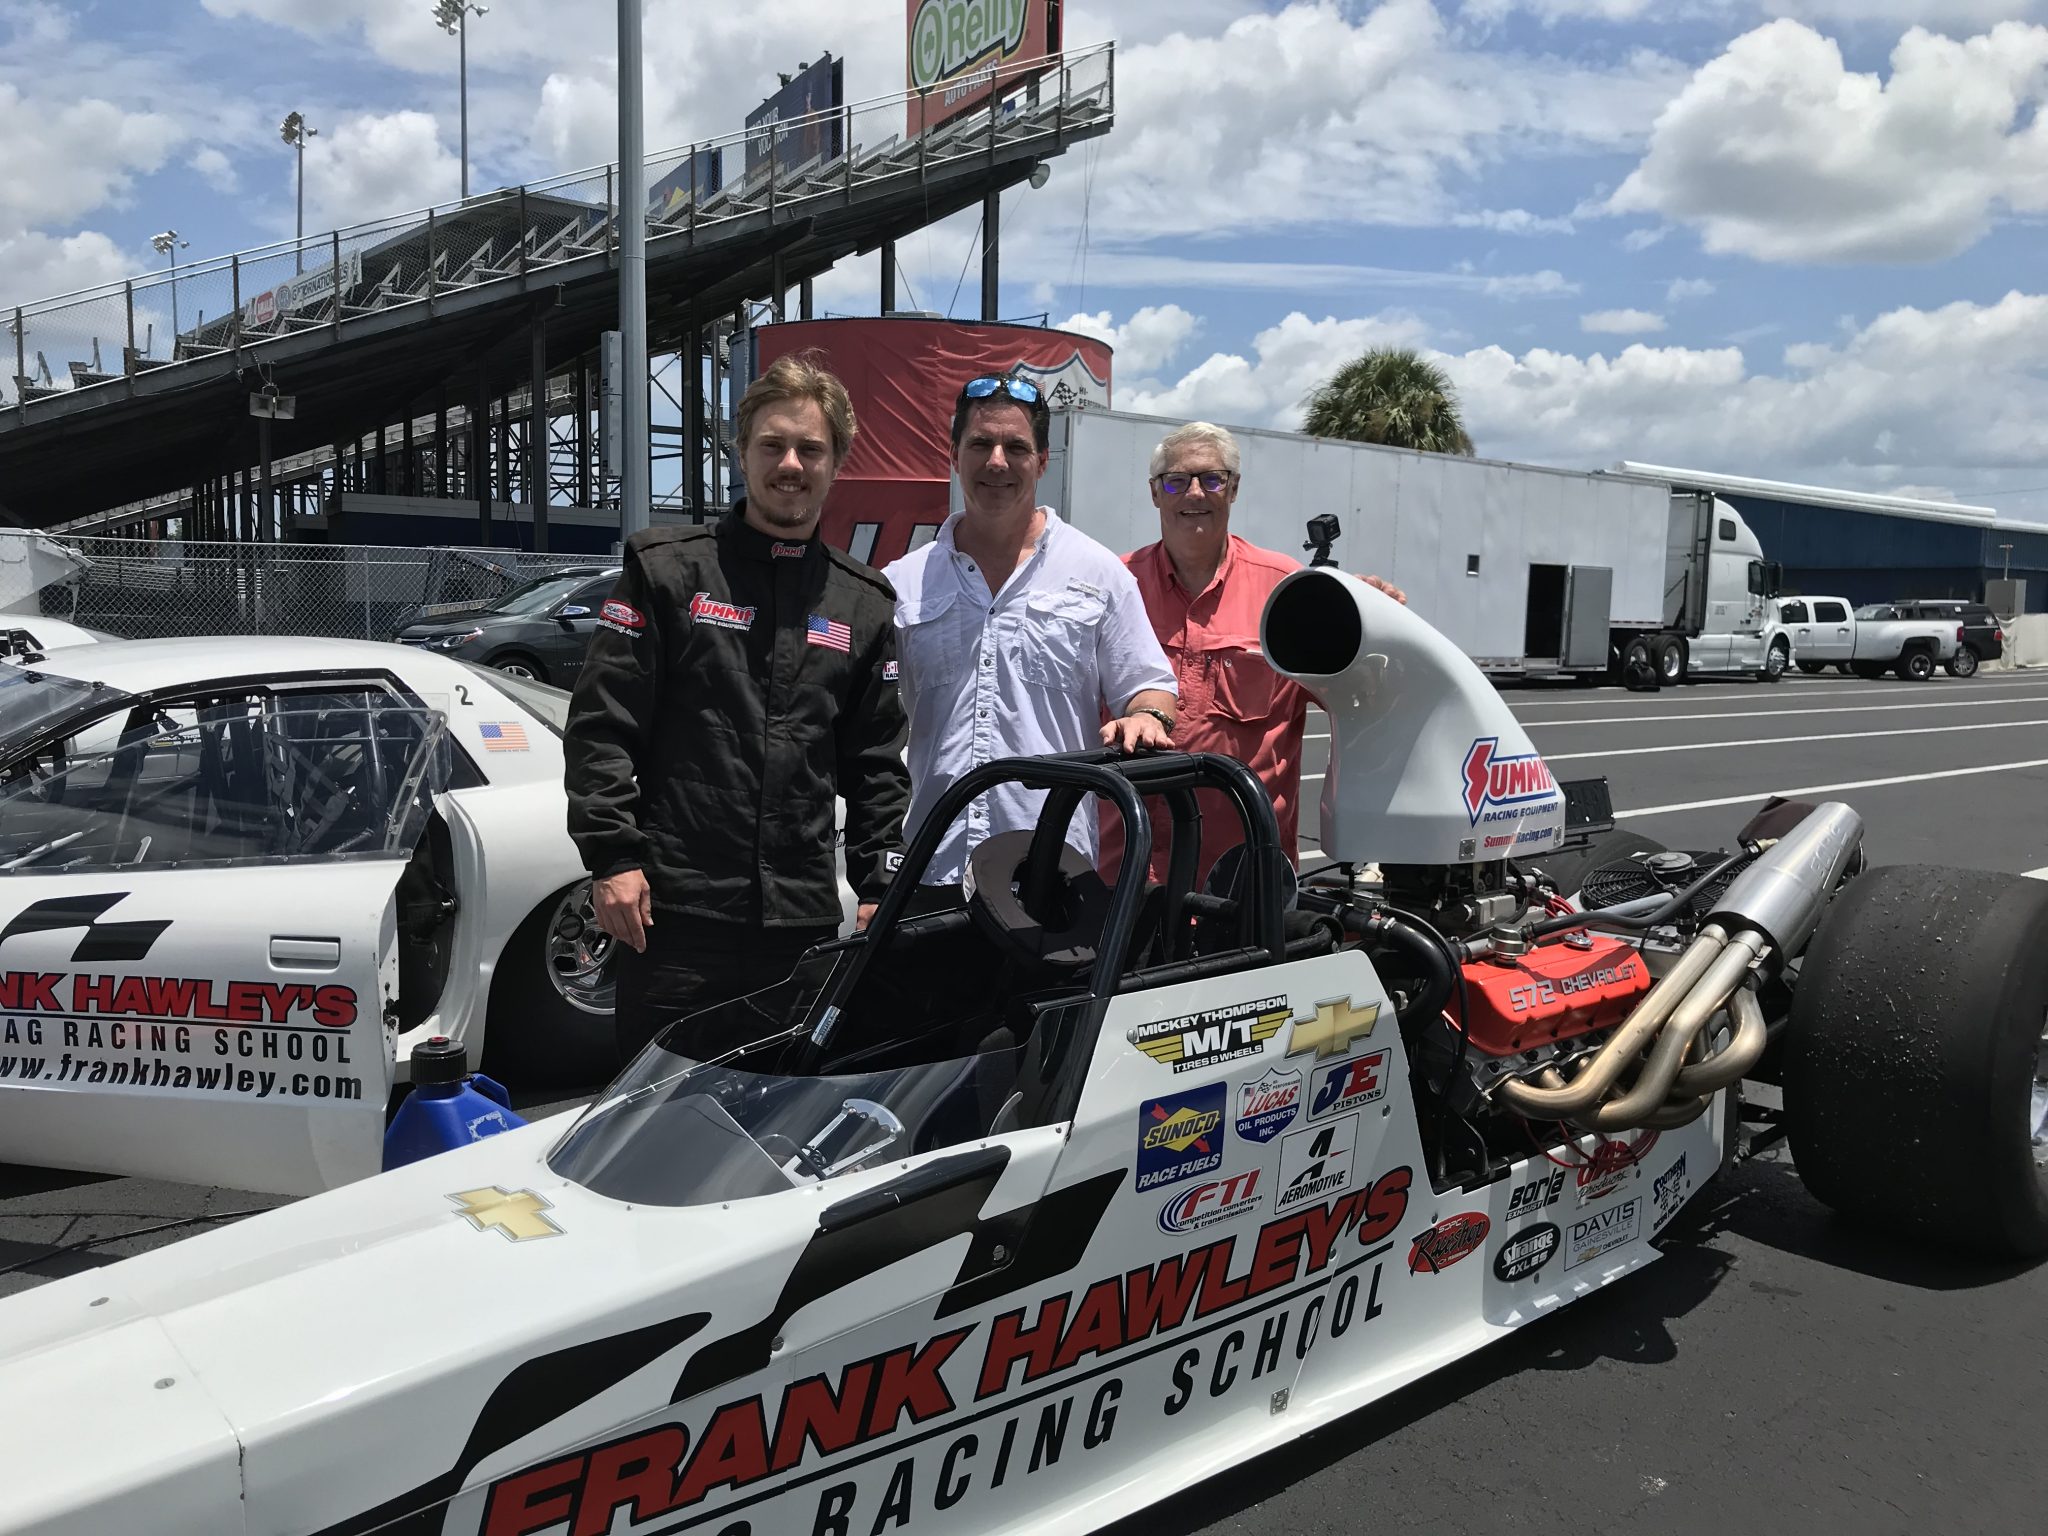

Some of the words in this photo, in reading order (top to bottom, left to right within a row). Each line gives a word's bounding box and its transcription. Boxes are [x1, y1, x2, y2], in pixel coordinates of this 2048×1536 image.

[944, 83, 968, 107] AUTO
[968, 59, 999, 92] PARTS
[689, 592, 755, 625] SUMMIT
[695, 617, 717, 627] RACING
[717, 620, 751, 632] EQUIPMENT
[455, 684, 474, 706] 2
[1483, 808, 1518, 823] RACING
[1520, 802, 1559, 817] EQUIPMENT
[1483, 827, 1553, 848] SummitRacing.com
[72, 973, 358, 1028] HAWLEY'S
[1509, 979, 1554, 1012] 572
[1560, 963, 1637, 995] CHEVROLET
[1138, 1015, 1200, 1038] MICKEY
[1202, 996, 1288, 1022] THOMPSON
[4, 1018, 42, 1045] AG
[64, 1021, 191, 1053] RACING
[214, 1028, 352, 1064] SCHOOL
[1182, 1017, 1260, 1058] M/T
[1174, 1058, 1210, 1073] TIRES
[1219, 1045, 1263, 1062] WHEELS
[0, 1053, 363, 1100] ww.frankhawley.com
[1311, 1053, 1384, 1117] JE
[1243, 1085, 1299, 1117] LUCAS
[1332, 1089, 1382, 1111] PISTONS
[1146, 1112, 1219, 1147] SUNOCO
[1237, 1119, 1253, 1132] OIL
[1254, 1107, 1297, 1128] PRODUCTS
[1258, 1126, 1276, 1138] INC.
[1137, 1167, 1178, 1189] RACE
[1178, 1153, 1222, 1177] FUELS
[1180, 1168, 1261, 1220] FTI
[1278, 1170, 1347, 1208] AEROMOTIVE
[1175, 1208, 1222, 1228] competition
[1222, 1194, 1263, 1213] converters
[1200, 1205, 1255, 1227] transmissions
[1506, 1200, 1543, 1220] EXHAUST
[1573, 1201, 1635, 1242] DAVIS
[1502, 1232, 1554, 1266] Strange
[1572, 1220, 1633, 1253] GAINESVILLE
[1602, 1233, 1629, 1251] CHEVROLET
[1507, 1250, 1549, 1279] AXLES
[477, 1322, 982, 1536] FRANK
[973, 1165, 1414, 1403] HAWLEY'S
[813, 1378, 1124, 1536] RACING
[1163, 1261, 1385, 1416] SCHOOL
